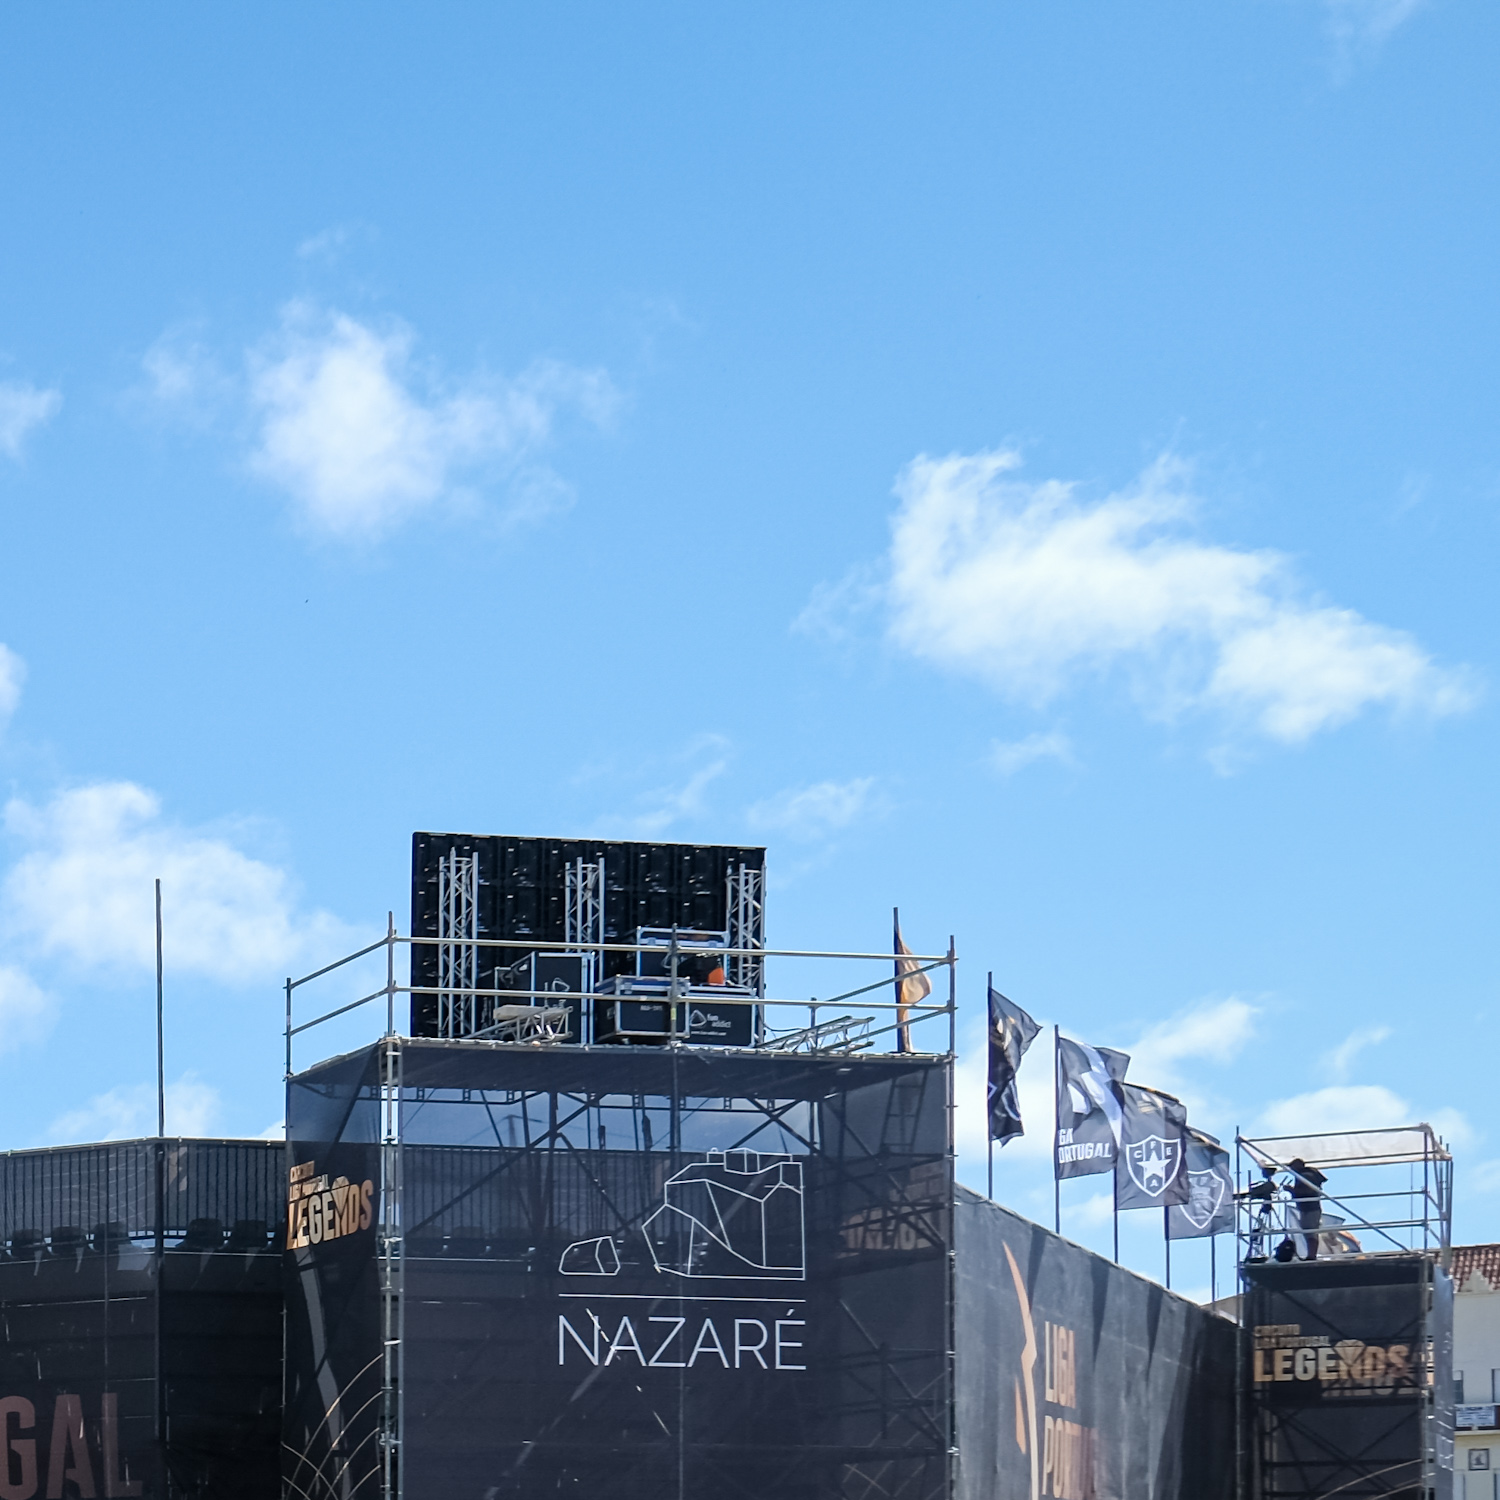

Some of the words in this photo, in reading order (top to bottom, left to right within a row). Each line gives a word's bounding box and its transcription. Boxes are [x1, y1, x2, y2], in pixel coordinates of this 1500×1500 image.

[1059, 1142, 1112, 1164] ORTUGAL
[286, 1176, 374, 1250] LEGENDS
[558, 1309, 806, 1370] NAZARÉ
[1254, 1339, 1410, 1382] LEGENDS
